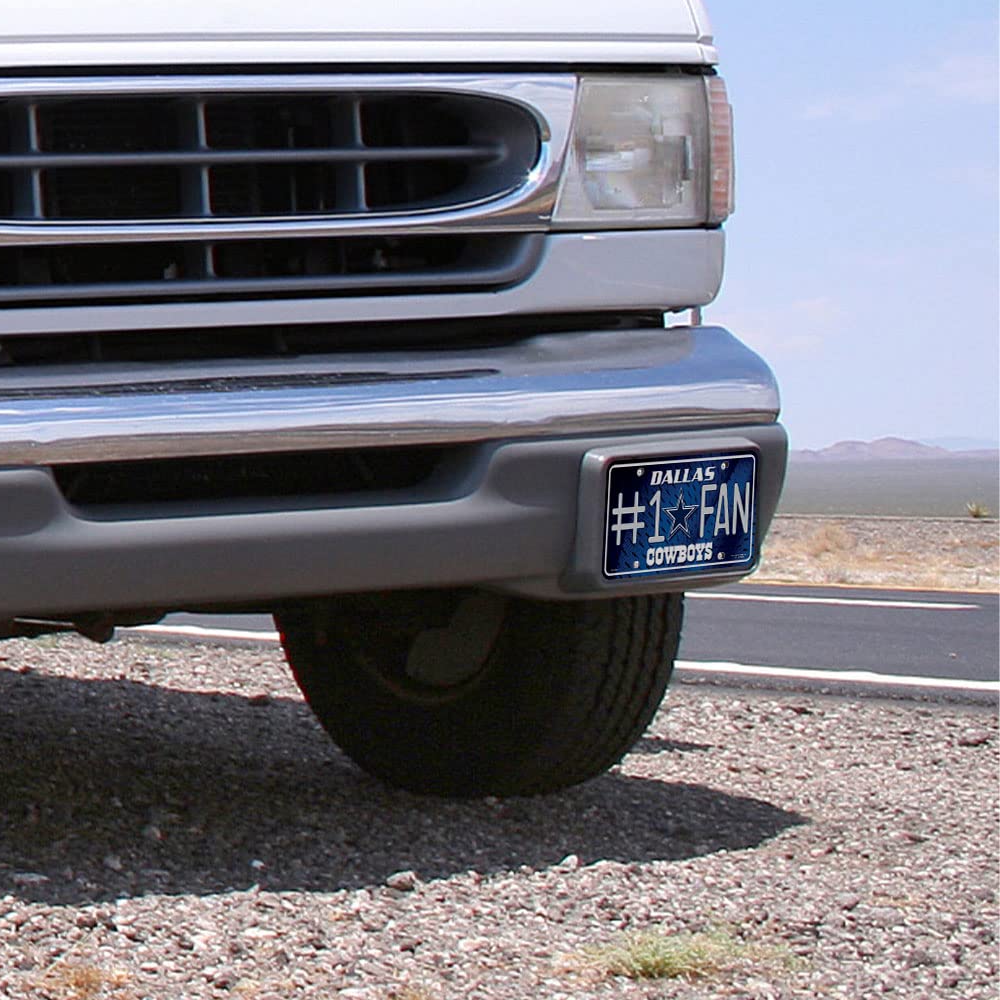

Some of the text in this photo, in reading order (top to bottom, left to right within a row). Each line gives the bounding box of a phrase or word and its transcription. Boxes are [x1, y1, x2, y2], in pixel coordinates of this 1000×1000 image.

[649, 466, 716, 486] DALLAS
[611, 482, 750, 546] #1 FAN
[646, 542, 713, 566] COWBOYS
